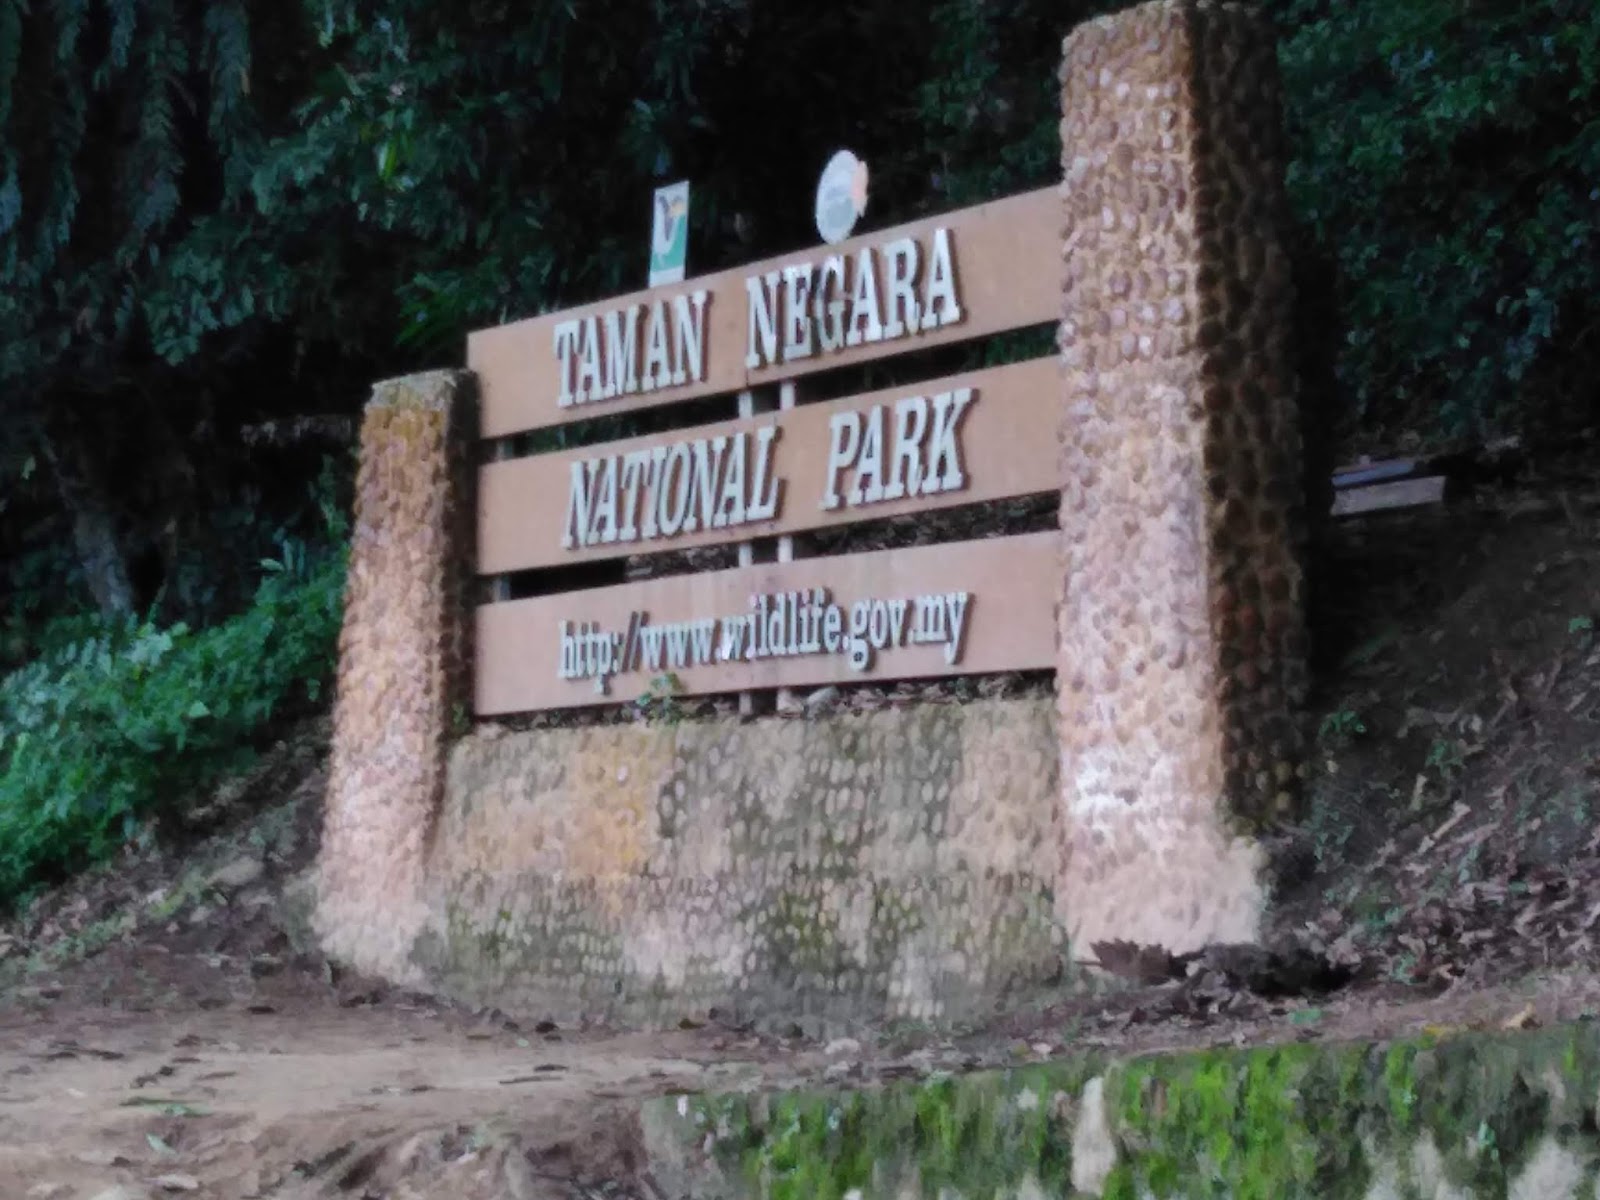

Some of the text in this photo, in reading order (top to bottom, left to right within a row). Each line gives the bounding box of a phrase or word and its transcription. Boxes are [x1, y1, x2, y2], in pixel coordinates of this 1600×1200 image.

[553, 227, 962, 409] TAMAN NEGARA
[562, 387, 974, 550] NATIONAL PARK
[557, 588, 970, 694] http://www.wildlife.gov.my
